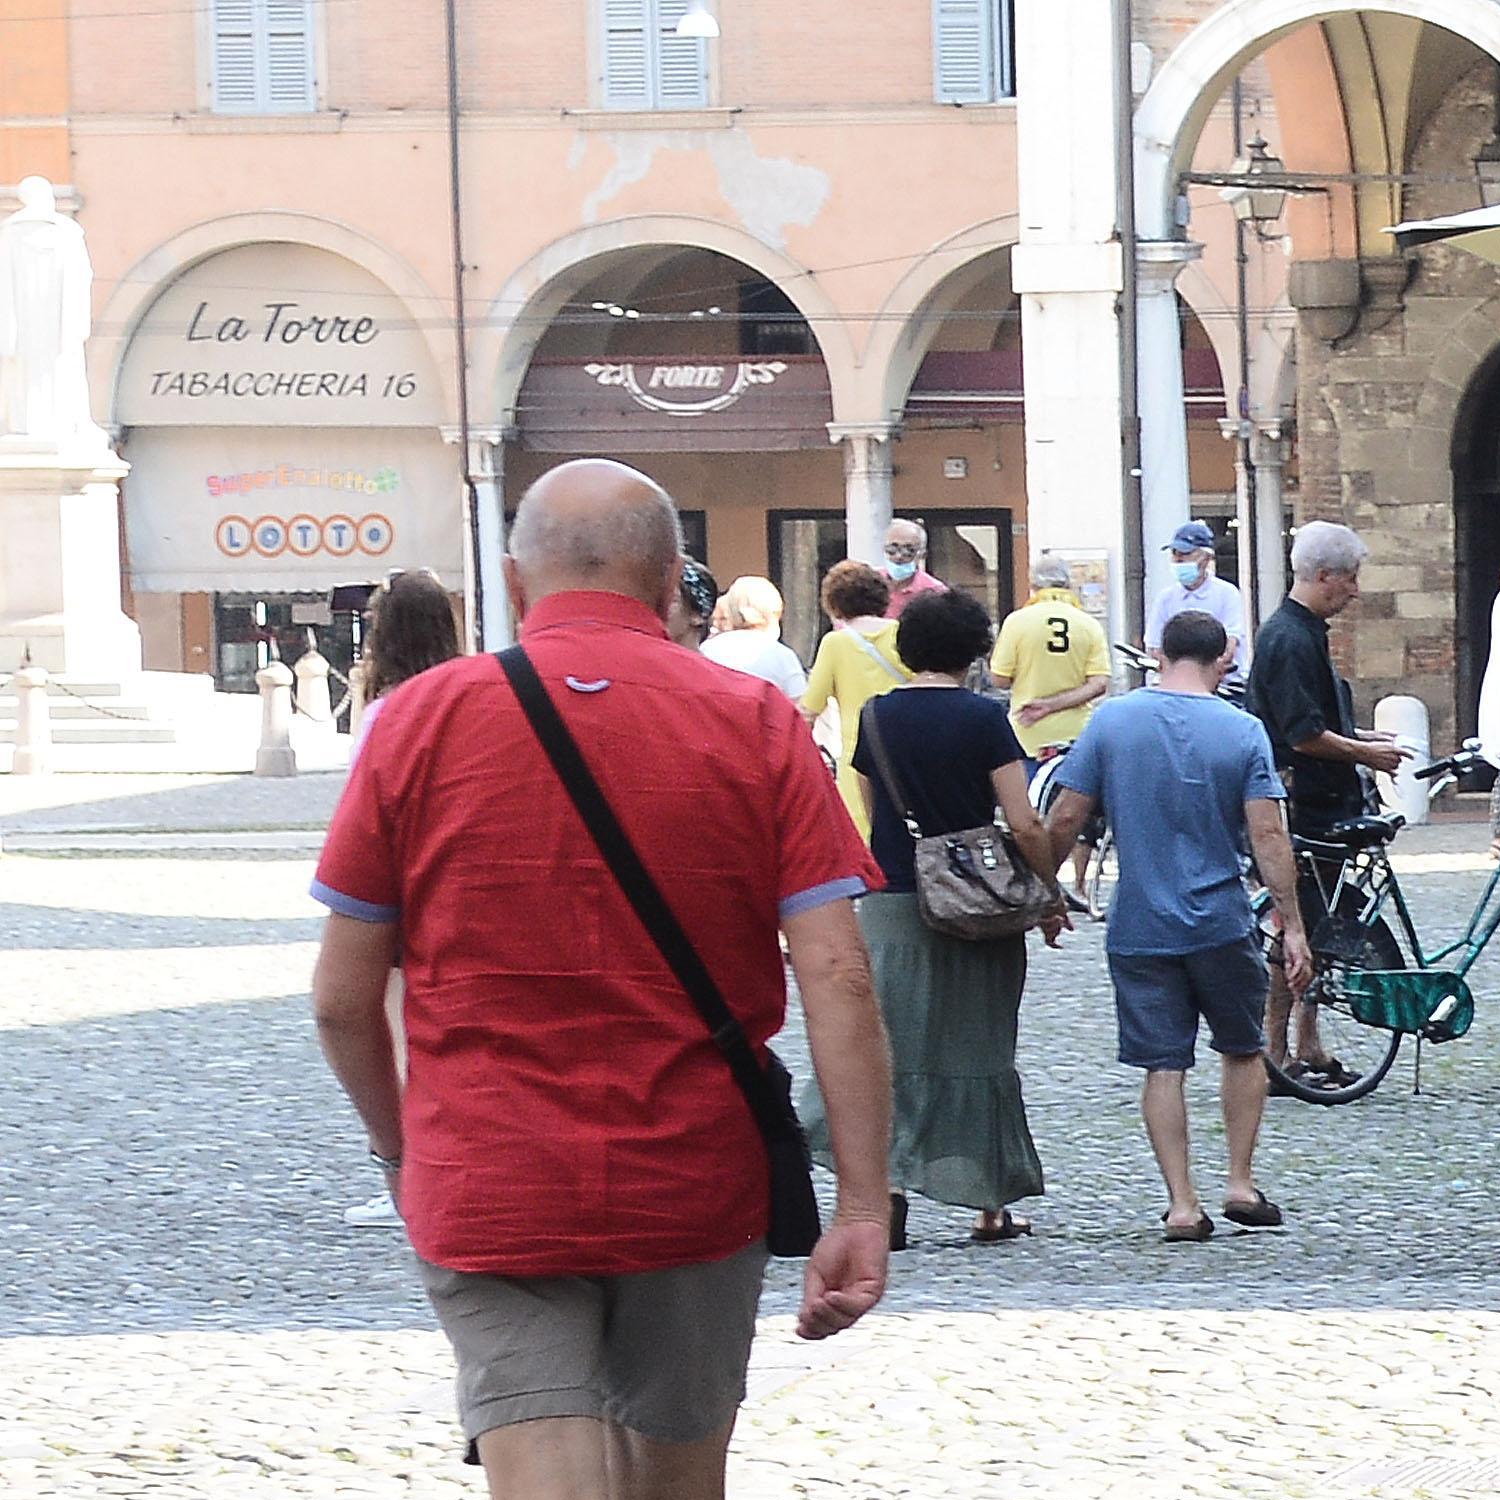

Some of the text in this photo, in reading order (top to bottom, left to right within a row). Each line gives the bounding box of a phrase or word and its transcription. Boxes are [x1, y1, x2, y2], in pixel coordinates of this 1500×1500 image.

[187, 301, 379, 344] La Torre
[151, 371, 417, 398] TABACCHERIA 16
[648, 365, 725, 389] FORTE
[225, 520, 384, 551] LOTTO
[1047, 617, 1070, 654] 3
